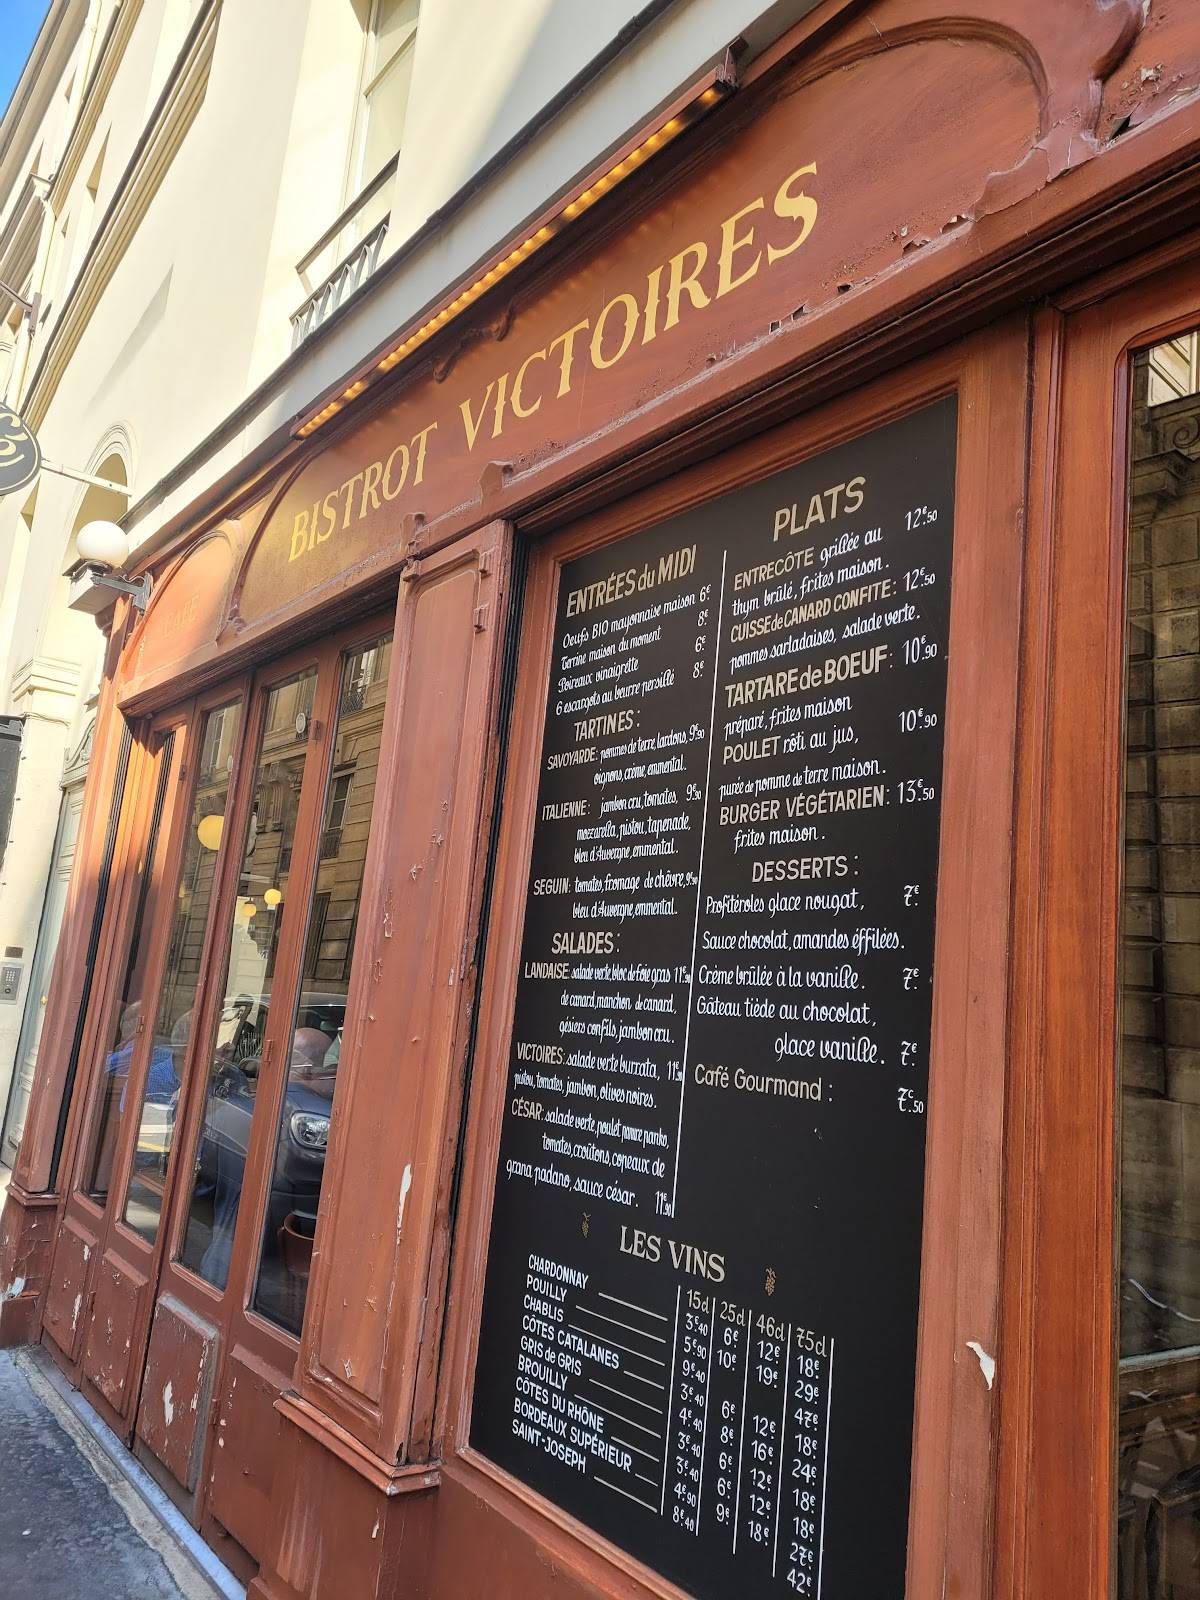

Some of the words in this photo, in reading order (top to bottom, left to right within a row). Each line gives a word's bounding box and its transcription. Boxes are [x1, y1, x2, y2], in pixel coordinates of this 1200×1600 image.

[288, 422, 438, 562] BISTROT
[459, 161, 818, 451] VICTOIRES
[773, 476, 866, 542] PLATS
[734, 546, 815, 591] ENTRECÔTE
[820, 532, 860, 568] grillée
[864, 528, 883, 546] au
[566, 569, 636, 617] ENTRÉES
[637, 564, 655, 591] du
[657, 544, 697, 584] MIDI
[732, 597, 760, 621] thym
[799, 573, 834, 601] frites
[562, 627, 589, 649] Oeufs
[592, 620, 609, 640] BIO
[611, 604, 661, 635] mayonnaise
[663, 592, 696, 614] maison
[730, 615, 771, 643] CUISSE
[771, 614, 784, 632] de
[784, 598, 831, 628] CANARD
[588, 644, 616, 662] maison
[618, 634, 631, 653] du
[630, 625, 662, 648] moment
[729, 648, 768, 676] pommes
[842, 613, 882, 639] salade
[595, 657, 639, 683] vinaigrette
[725, 667, 798, 708] TARTARE
[800, 664, 822, 691] de
[556, 702, 563, 716] 6
[563, 693, 601, 715] escargots
[602, 689, 613, 704] au
[615, 678, 640, 701] beurre
[642, 669, 675, 697] persillé
[769, 704, 801, 731] frites
[804, 695, 853, 719] maison
[600, 743, 627, 765] pommes
[627, 737, 637, 755] de
[722, 735, 781, 765] POULET
[783, 732, 806, 754] rôti
[810, 733, 827, 748] au
[718, 776, 744, 802] purée
[744, 779, 754, 793] de
[755, 774, 791, 797] pomme
[792, 772, 803, 787] de
[803, 766, 829, 784] terre
[598, 794, 627, 819] jambon
[719, 799, 781, 826] BURGER
[734, 828, 765, 854] frites
[604, 873, 640, 894] fromage
[644, 871, 653, 889] de
[768, 892, 801, 918] glace
[702, 930, 737, 950] Sauce
[793, 928, 850, 950] amandes
[627, 965, 635, 982] de
[651, 969, 671, 989] gras
[698, 964, 734, 985] Crème
[735, 965, 773, 987] brûlée
[776, 967, 787, 987] à
[788, 966, 803, 988] la
[561, 989, 570, 1006] de
[597, 992, 632, 1011] manchon
[635, 994, 644, 1011] de
[696, 995, 742, 1017] Gâteau
[744, 997, 775, 1019] tiède
[779, 1004, 799, 1021] au
[559, 1016, 586, 1037] gésiers
[619, 1020, 652, 1043] jambon
[566, 1050, 595, 1070] salade
[597, 1053, 618, 1073] verte
[774, 1032, 816, 1062] glace
[600, 1083, 625, 1102] olives
[694, 1063, 729, 1089] Café
[544, 1106, 575, 1128] salade
[506, 1158, 533, 1180] grana
[573, 1176, 604, 1198] sauce
[612, 1150, 650, 1175] copeaux
[652, 1156, 665, 1178] de
[620, 1225, 661, 1263] LES
[668, 1239, 726, 1283] VINS
[526, 1274, 567, 1302] POUILLY
[528, 1254, 589, 1290] CHARDONNAY
[524, 1294, 564, 1323] CHABLIS
[521, 1335, 544, 1359] GRIS
[544, 1348, 556, 1364] de
[558, 1351, 582, 1377] GRIS
[522, 1314, 554, 1341] CÔTES
[557, 1330, 619, 1370] CATALANES
[518, 1354, 568, 1391] BROUILLY
[516, 1376, 549, 1405] CÔTES
[552, 1393, 566, 1413] DU
[567, 1401, 604, 1434] RHÔNE
[512, 1419, 586, 1474] SAINT-JOSEPH
[514, 1397, 568, 1439] BORDEAUX
[570, 1427, 632, 1472] SUPÉRIEUR
